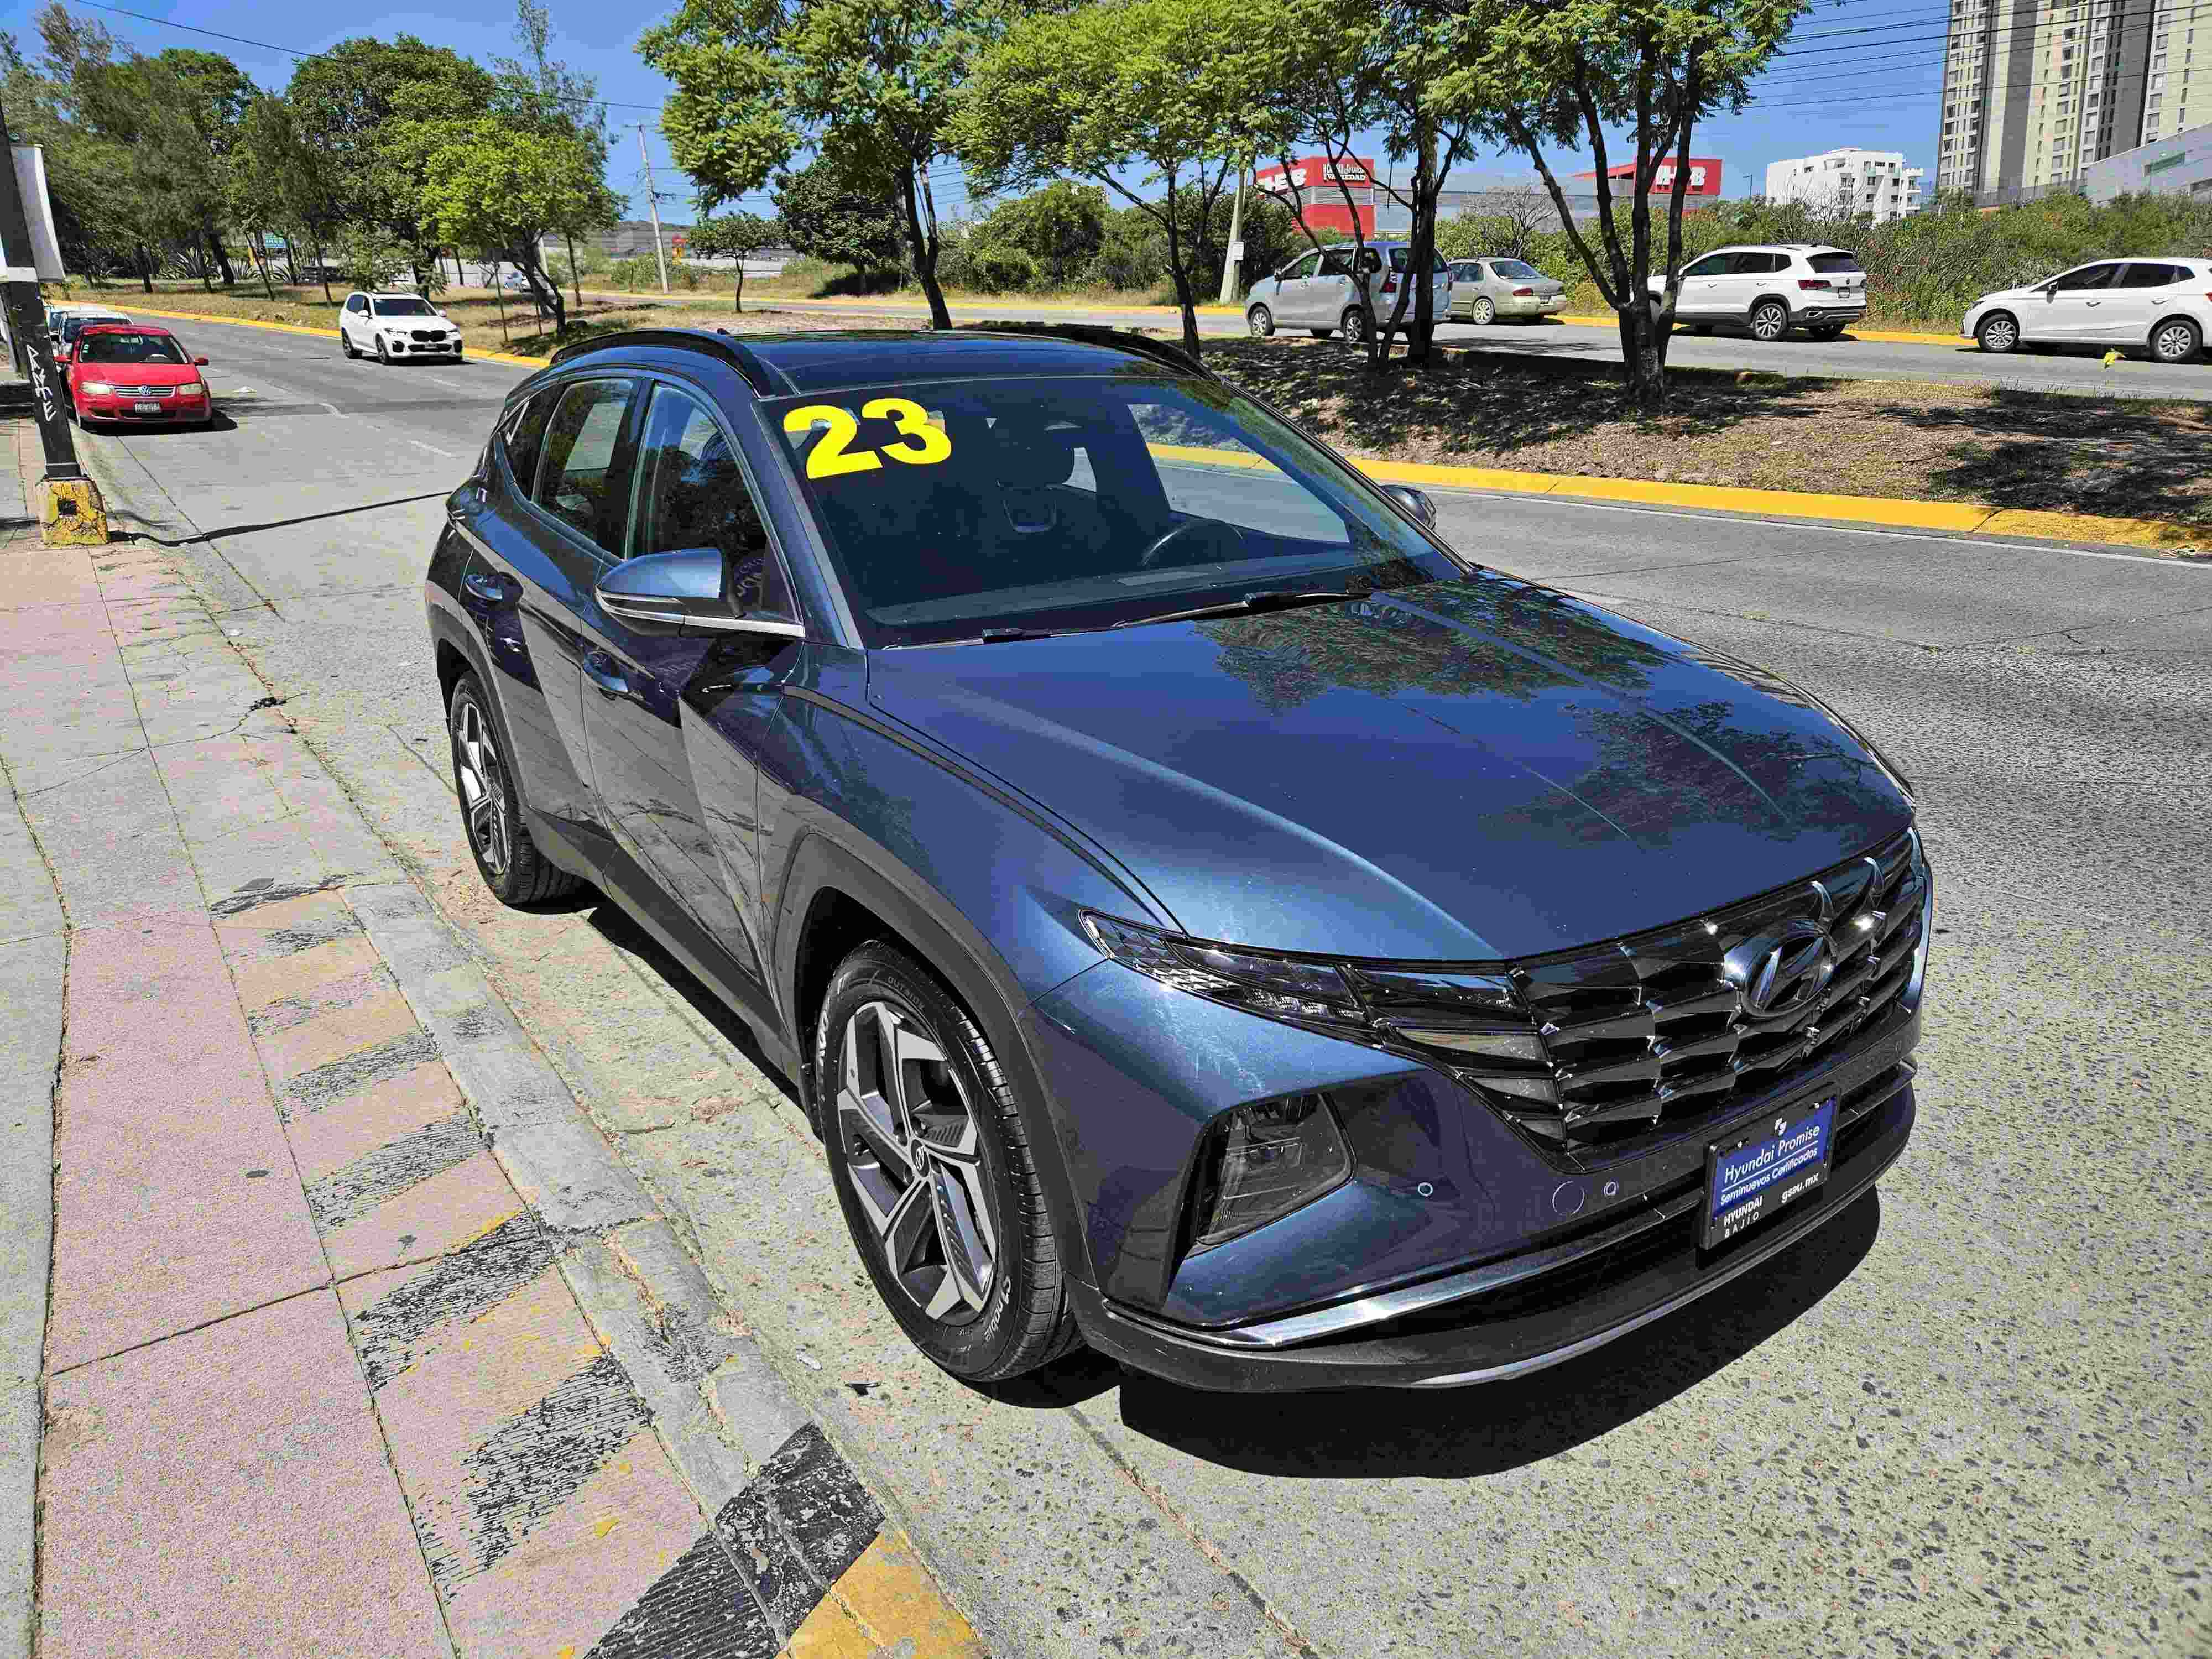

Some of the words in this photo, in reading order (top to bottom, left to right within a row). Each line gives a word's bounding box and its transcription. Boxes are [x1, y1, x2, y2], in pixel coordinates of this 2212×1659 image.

[783, 398, 952, 479] 23
[1720, 1173, 1770, 1206] Seminuevos
[1772, 1147, 1818, 1179] Certificados
[1724, 1144, 1775, 1183] Hyundai
[1778, 1126, 1820, 1156] Promise
[1724, 1195, 1763, 1228] HYUNDAI
[1781, 1172, 1819, 1204] gsau.mx
